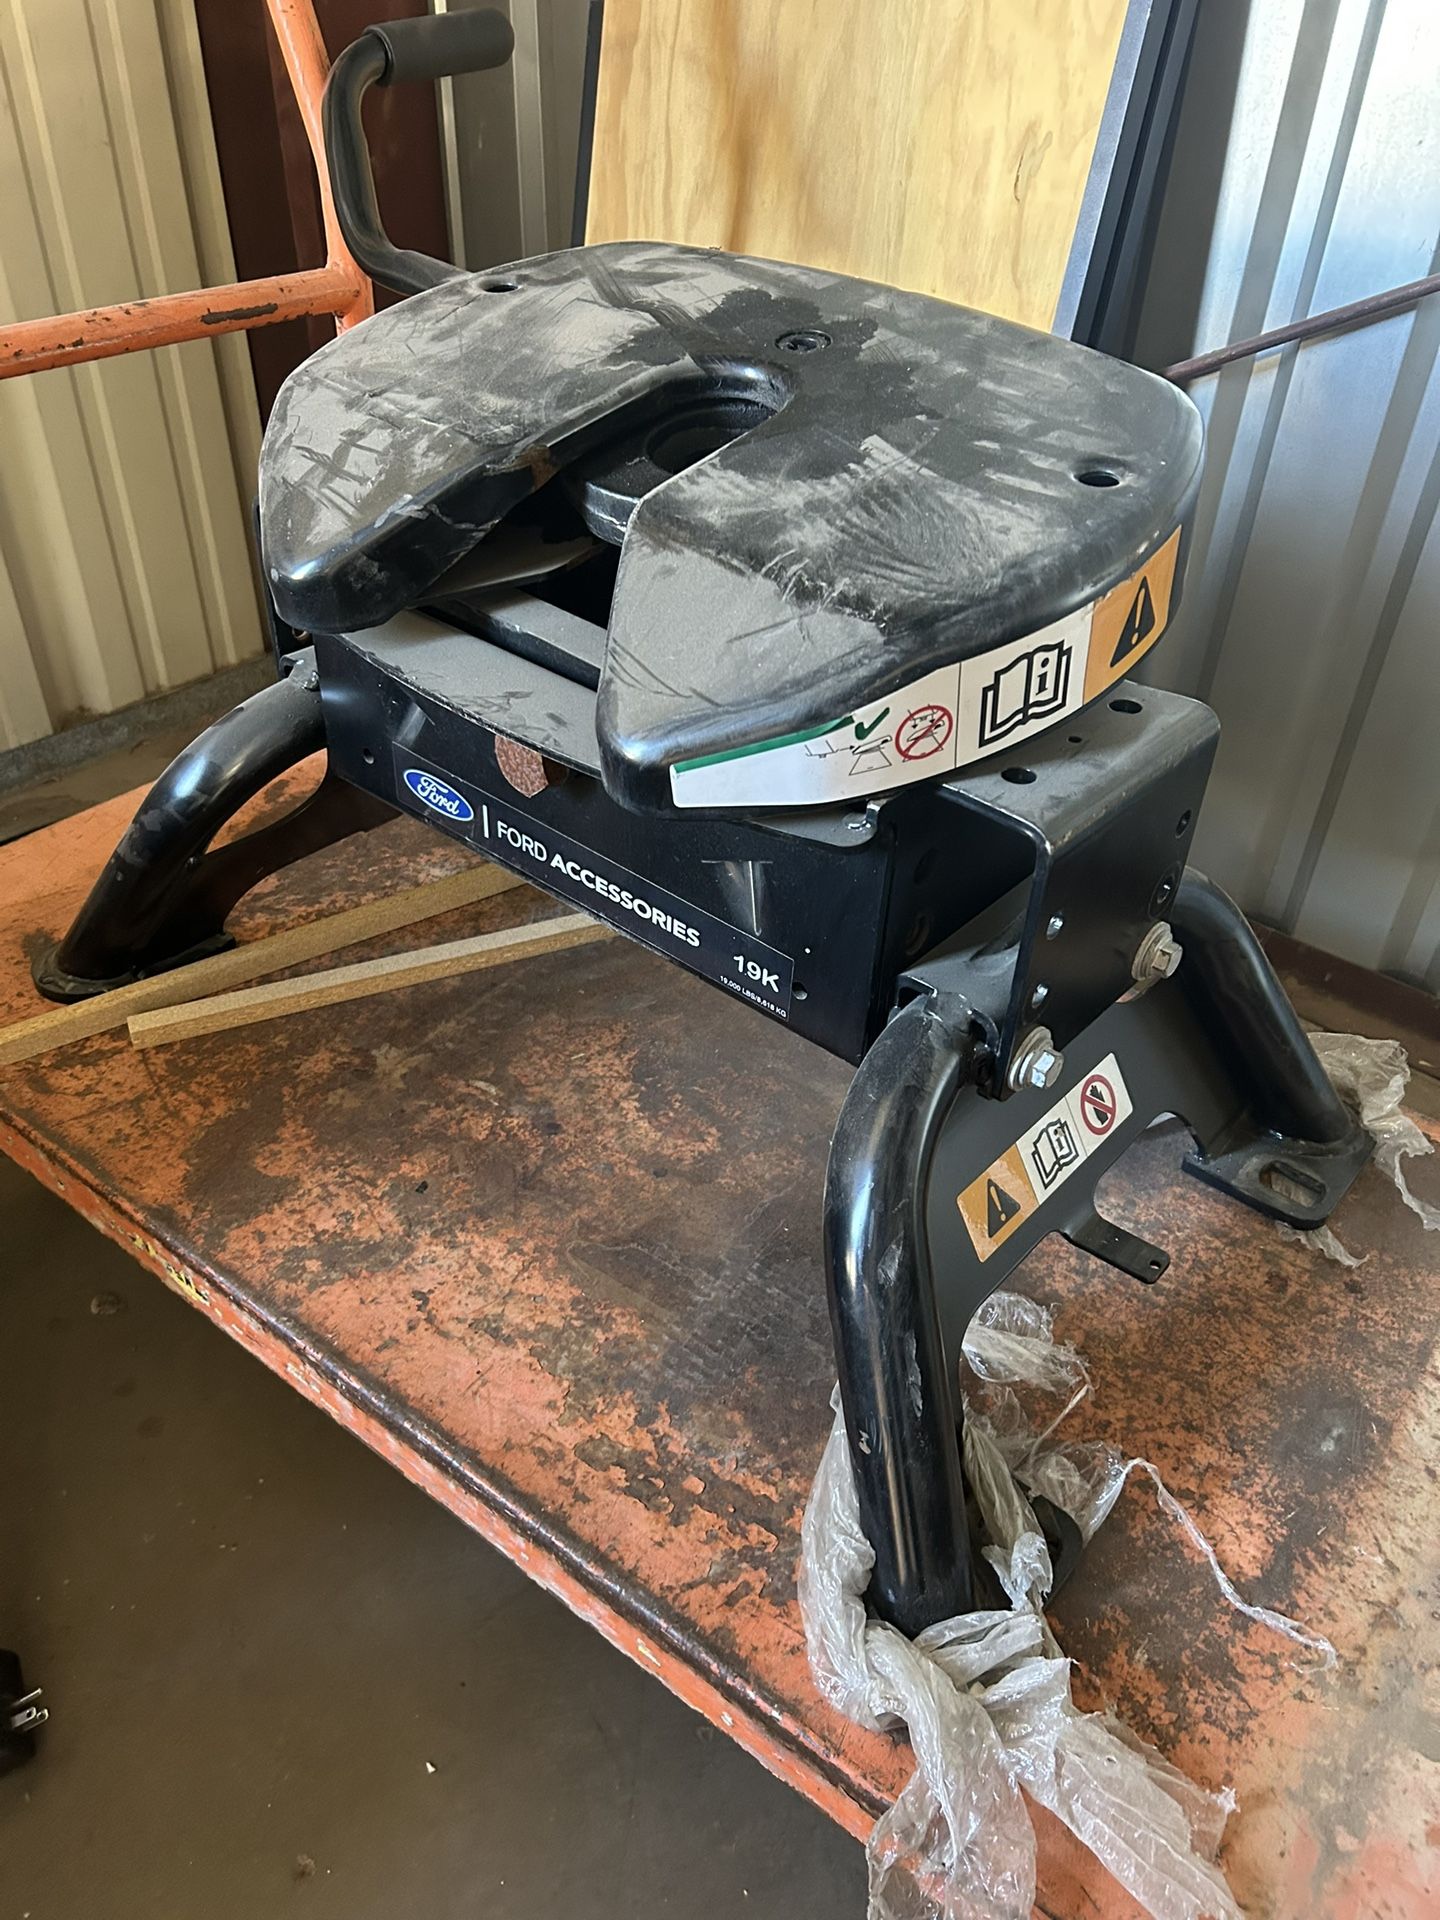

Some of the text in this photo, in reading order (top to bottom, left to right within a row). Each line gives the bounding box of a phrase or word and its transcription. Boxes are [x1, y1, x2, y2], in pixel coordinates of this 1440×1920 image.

[416, 776, 460, 816] Ford
[497, 820, 700, 947] FORD ACCESSORIES
[733, 955, 779, 993] 19K
[720, 975, 741, 992] 19,000
[775, 1006, 787, 1018] KG
